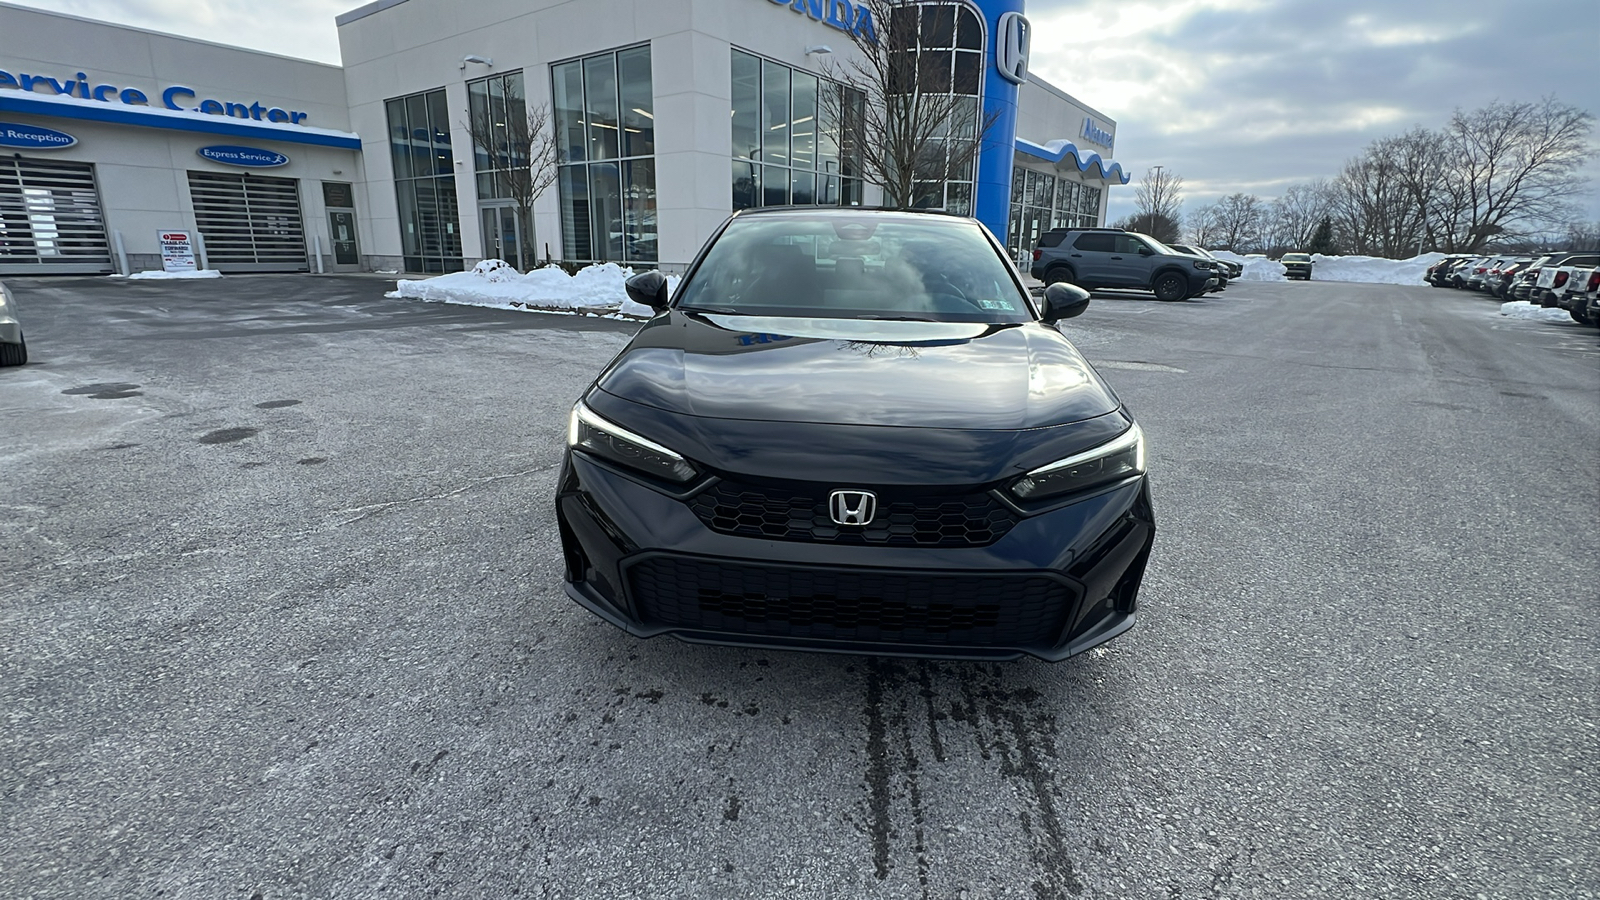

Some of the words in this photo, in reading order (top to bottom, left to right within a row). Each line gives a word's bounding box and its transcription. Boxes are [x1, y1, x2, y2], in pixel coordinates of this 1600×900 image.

[768, 0, 879, 46] NDA
[162, 86, 308, 124] Center
[7, 130, 69, 143] Reception
[203, 149, 238, 159] Express
[240, 152, 271, 162] Service
